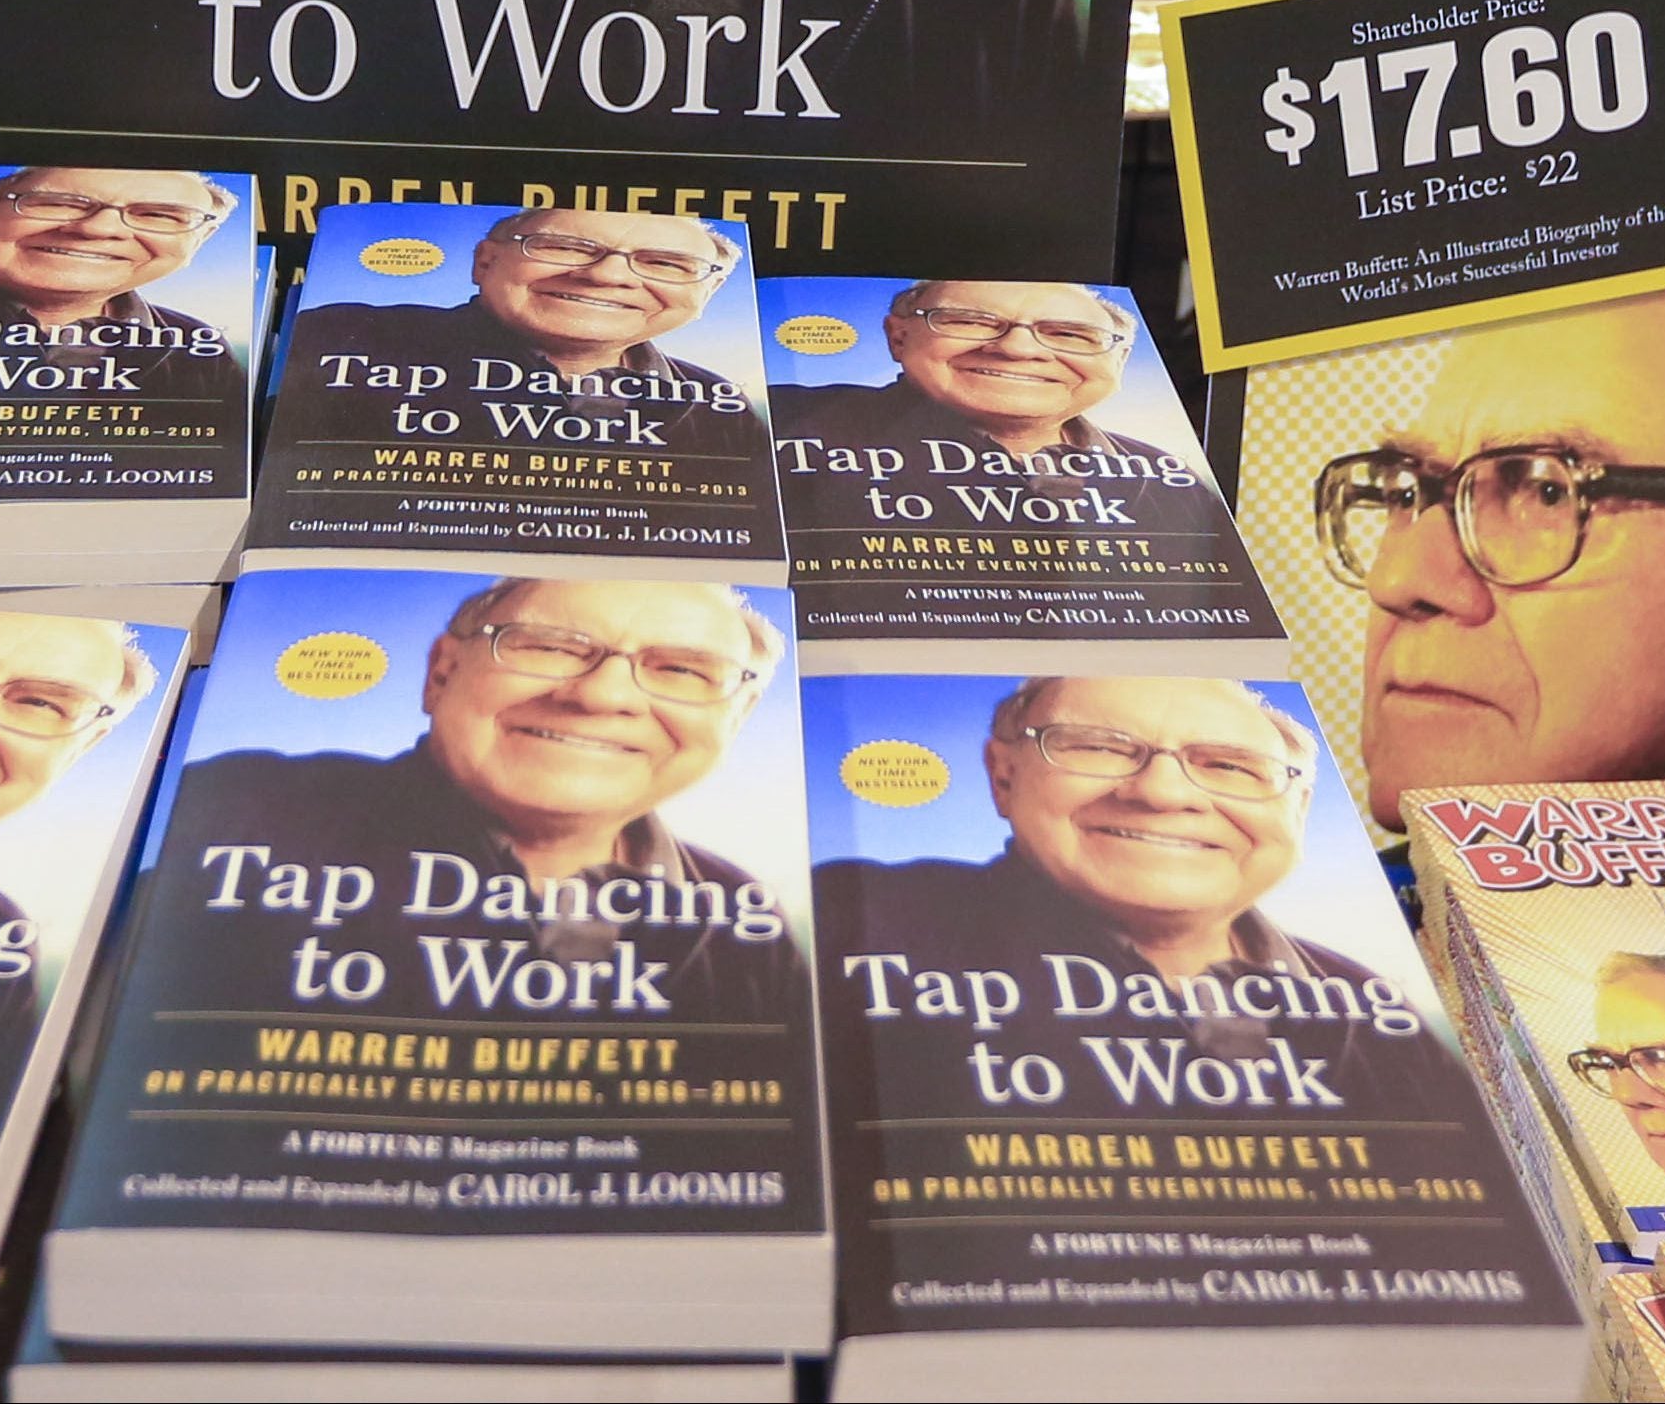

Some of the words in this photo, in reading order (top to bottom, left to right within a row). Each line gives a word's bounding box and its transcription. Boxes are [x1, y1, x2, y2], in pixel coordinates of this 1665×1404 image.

[1352, 8, 1480, 45] Shareholder
[1262, 11, 1649, 177] $17.60
[1357, 187, 1416, 220] List
[1424, 174, 1508, 206] Price:
[1526, 151, 1579, 186] $22
[1275, 269, 1339, 292] Warren
[1345, 256, 1409, 281] Buffett:
[1414, 249, 1441, 266] An
[1446, 230, 1530, 262] Illustrated
[1535, 215, 1621, 245] Biography
[1624, 208, 1644, 227] of
[1341, 277, 1408, 304] World's
[1413, 272, 1458, 292] Most
[1463, 253, 1547, 282] Successful
[1551, 241, 1619, 265] Investor
[202, 844, 374, 924] Tap
[402, 851, 783, 939] Dancing
[293, 933, 385, 999] to
[417, 937, 671, 1012] Work
